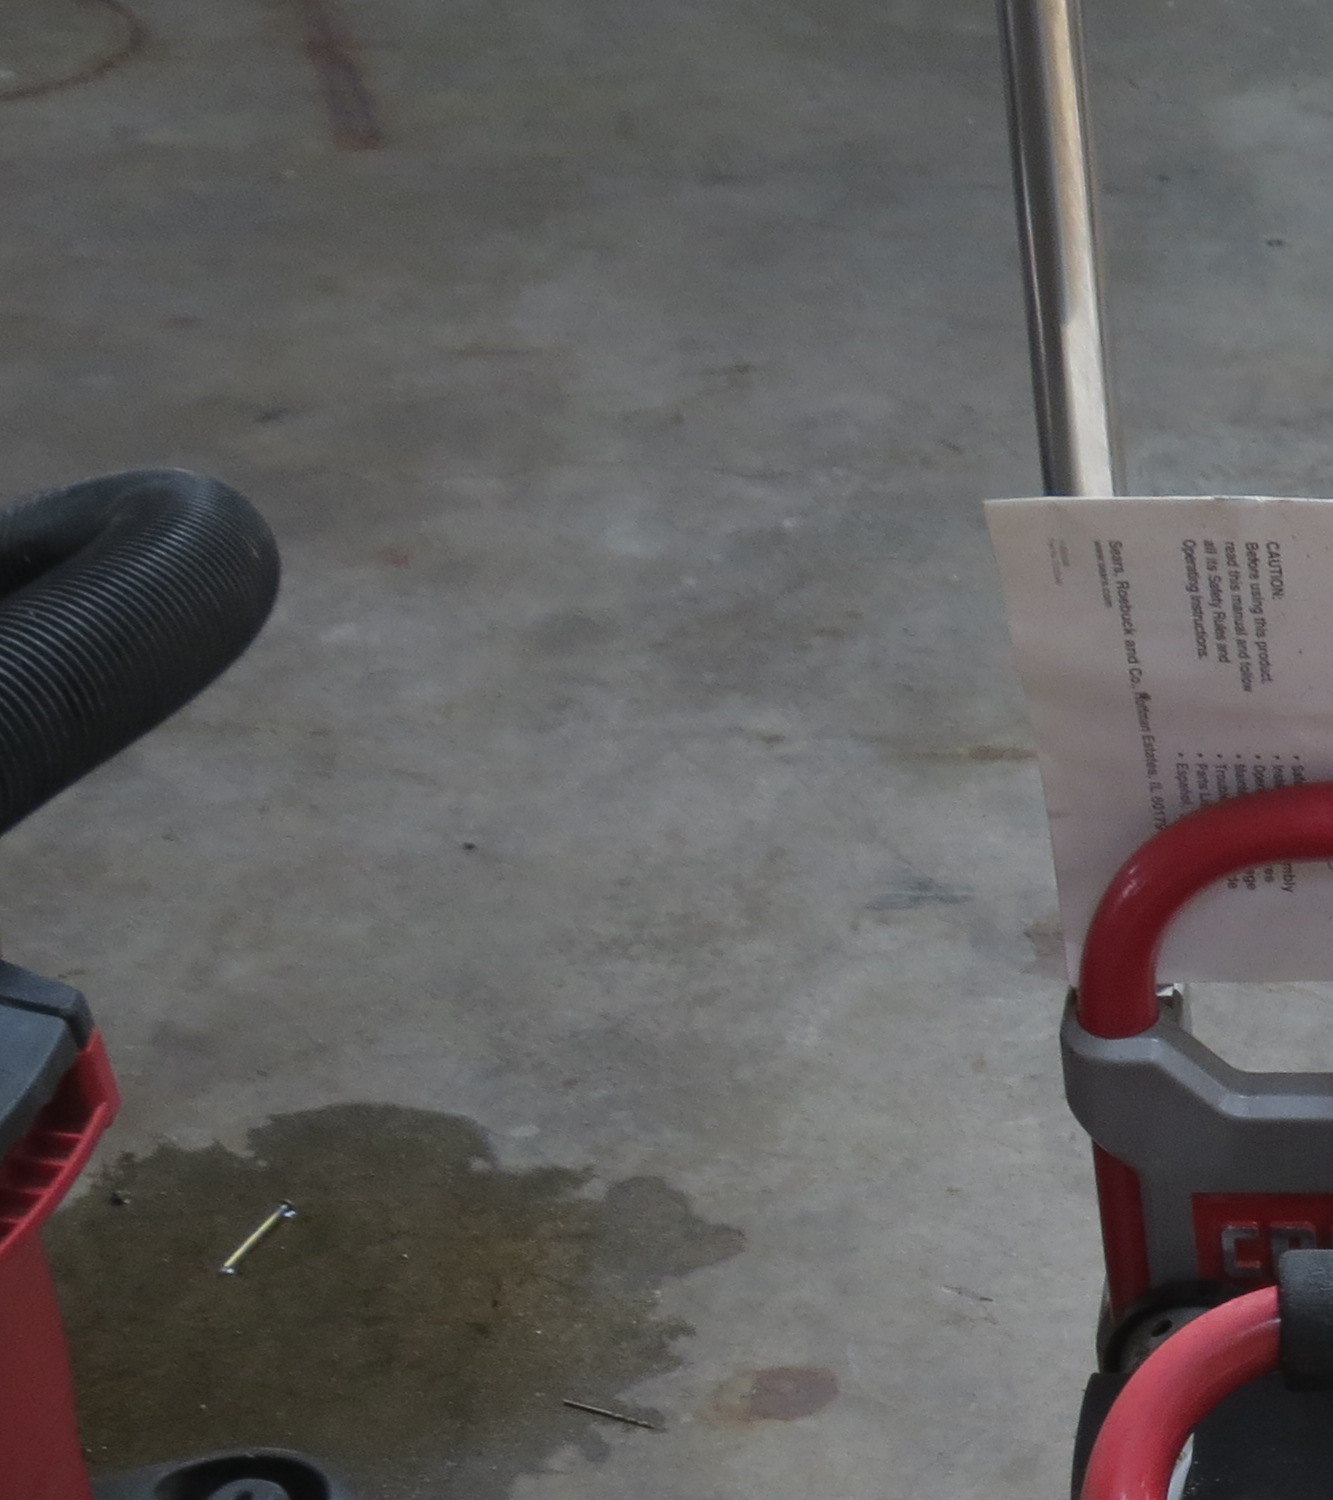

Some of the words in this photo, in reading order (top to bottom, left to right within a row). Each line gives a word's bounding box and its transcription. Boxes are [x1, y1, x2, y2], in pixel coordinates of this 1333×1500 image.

[1109, 541, 1126, 576] Sears,
[1204, 540, 1218, 554] all
[1226, 542, 1241, 567] read
[1246, 542, 1264, 580] Before
[1095, 541, 1113, 608] www.sears.com
[1180, 539, 1203, 592] Operating
[1206, 558, 1219, 571] its
[1266, 542, 1284, 600] CAUTION:
[1207, 576, 1224, 608] Safety
[1229, 571, 1243, 591] this
[1115, 581, 1137, 635] Roebuck
[1249, 584, 1266, 614] using
[1189, 595, 1209, 659] Instructions.
[1213, 611, 1226, 641] Rules
[1231, 595, 1247, 635] manual
[1254, 618, 1268, 638] this
[1126, 640, 1142, 664] and
[1216, 644, 1230, 663] and
[1235, 639, 1249, 660] and
[1239, 663, 1253, 692] follow
[1141, 735, 1158, 778] Estates,
[1150, 782, 1161, 793] IL
[1195, 763, 1209, 790] Parts
